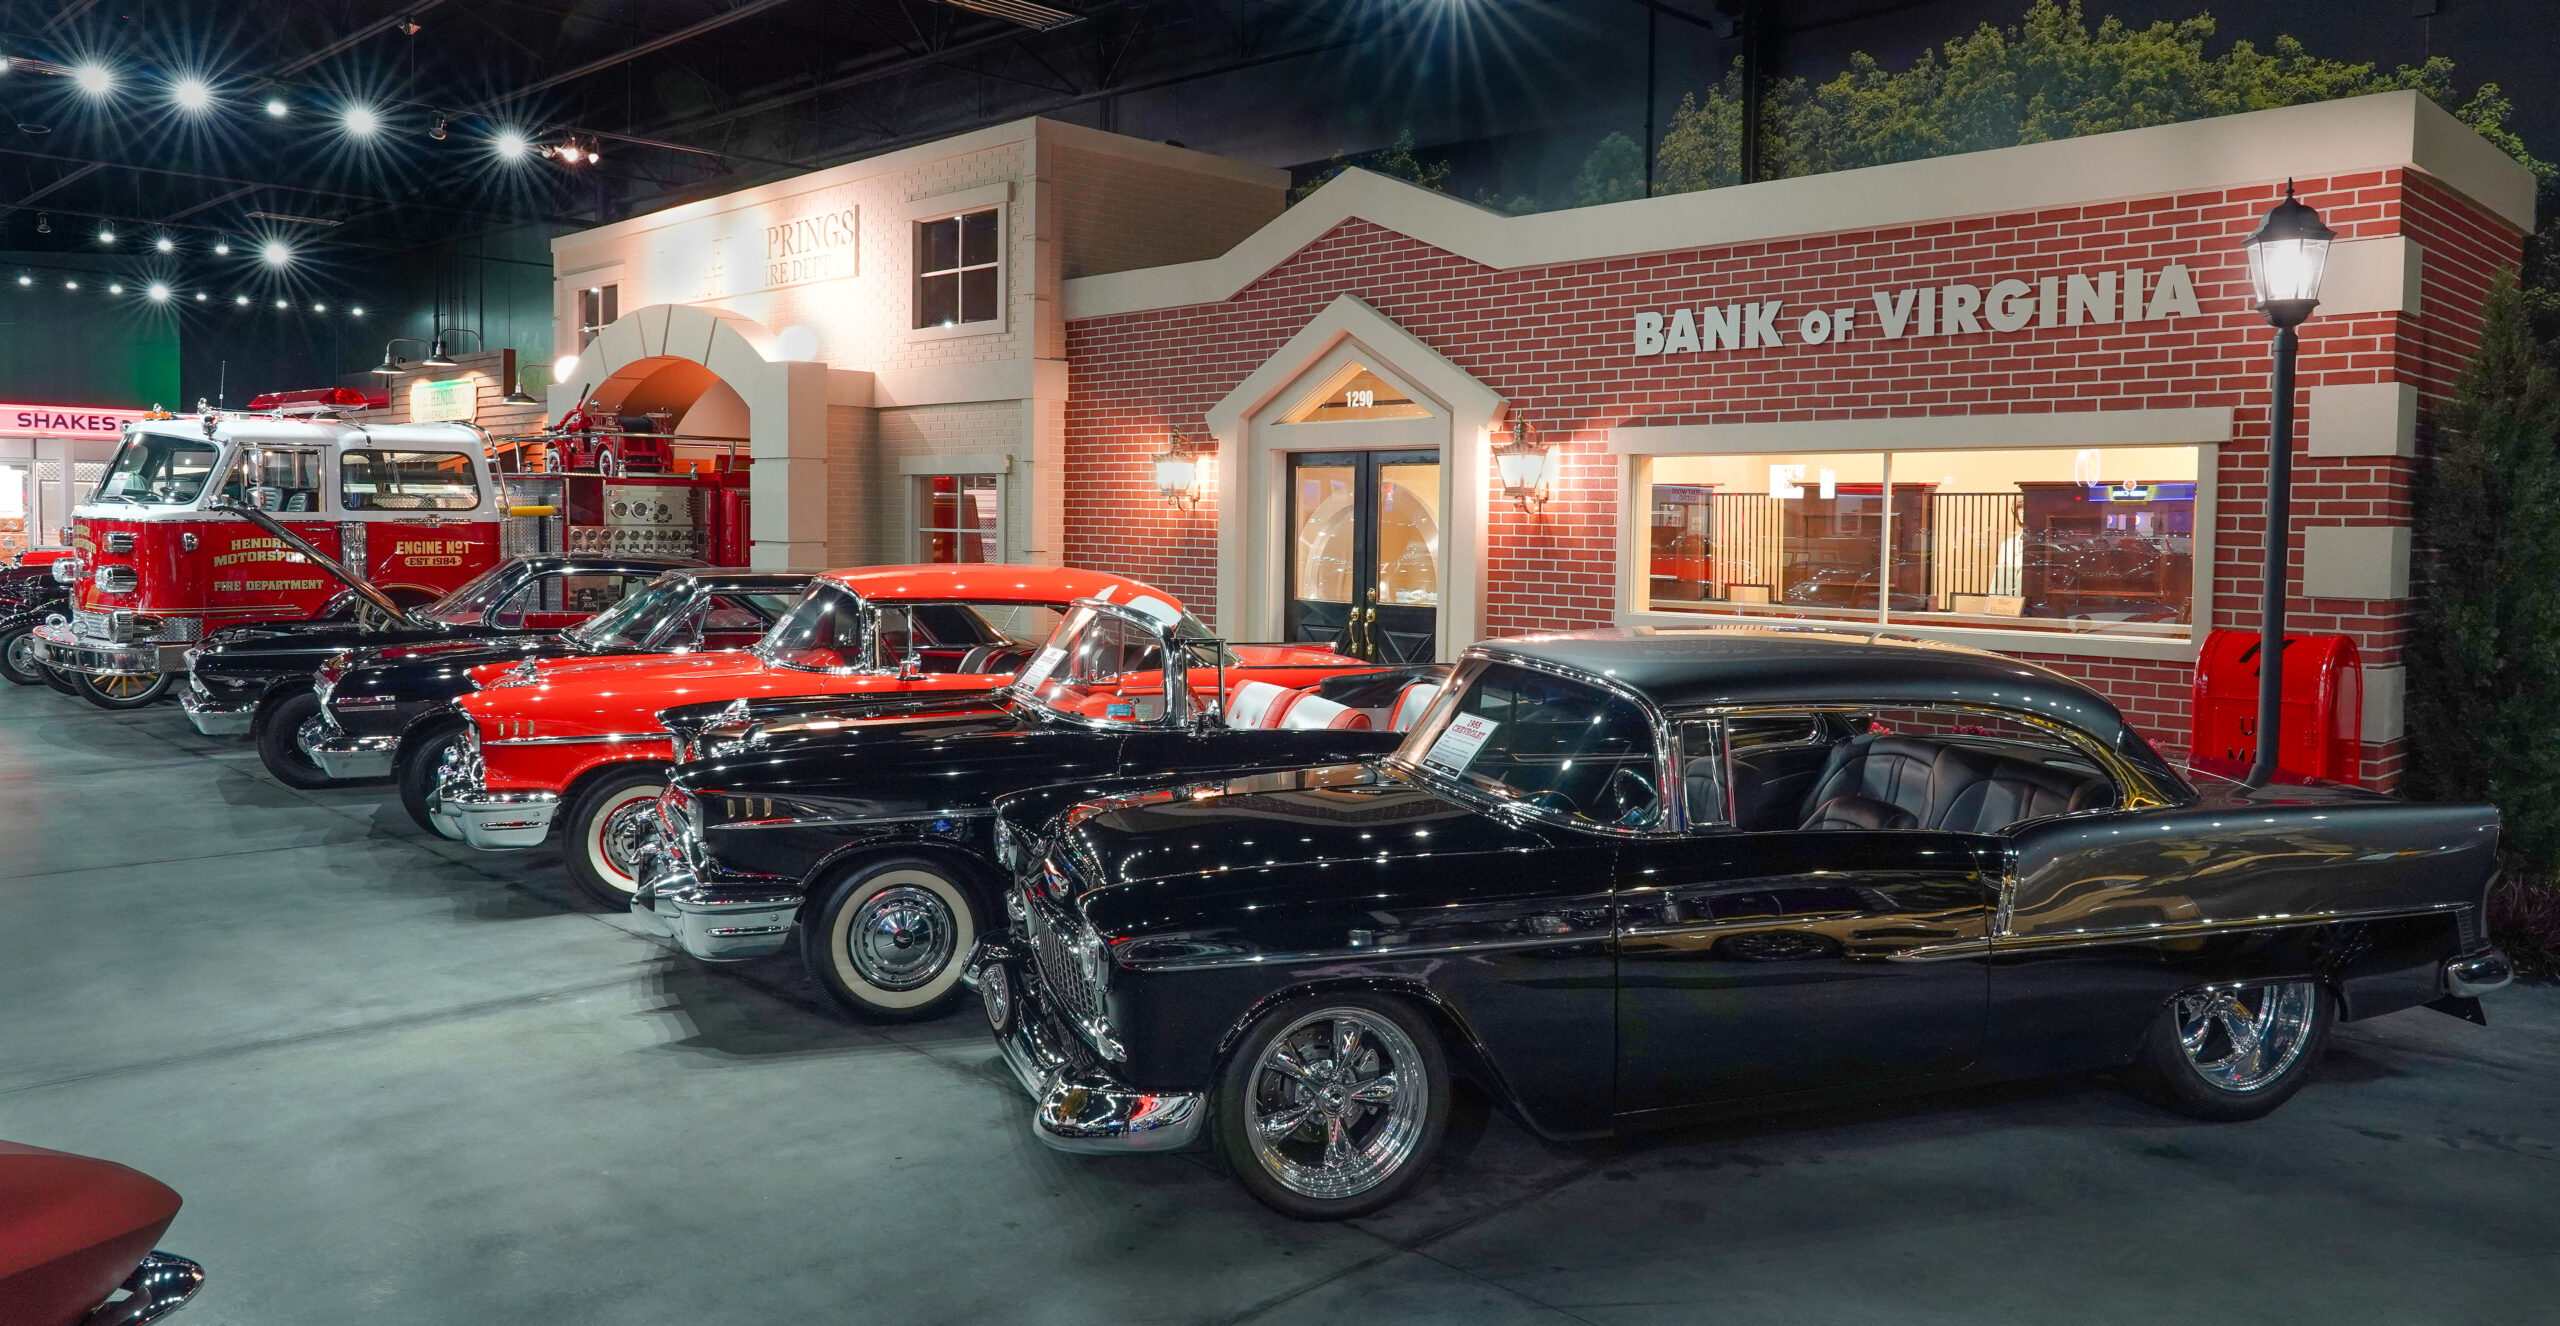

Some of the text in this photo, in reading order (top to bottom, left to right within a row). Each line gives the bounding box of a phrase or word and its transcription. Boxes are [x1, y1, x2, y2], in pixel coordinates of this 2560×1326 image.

[764, 209, 855, 260] PRINGS
[764, 262, 789, 287] IRE
[1635, 263, 2201, 357] BANK OF VIRGINIA
[1345, 389, 1374, 409] 1290
[17, 412, 116, 431] SHAKES
[231, 537, 293, 551] HENDRI
[396, 541, 442, 555] ENGINE
[213, 550, 313, 568] MOTORSPOR
[433, 557, 456, 565] 1984
[213, 579, 324, 592] FIRE DEPARTMENT
[1452, 724, 1486, 740] CHEVROLET
[1467, 719, 1483, 730] 1955
